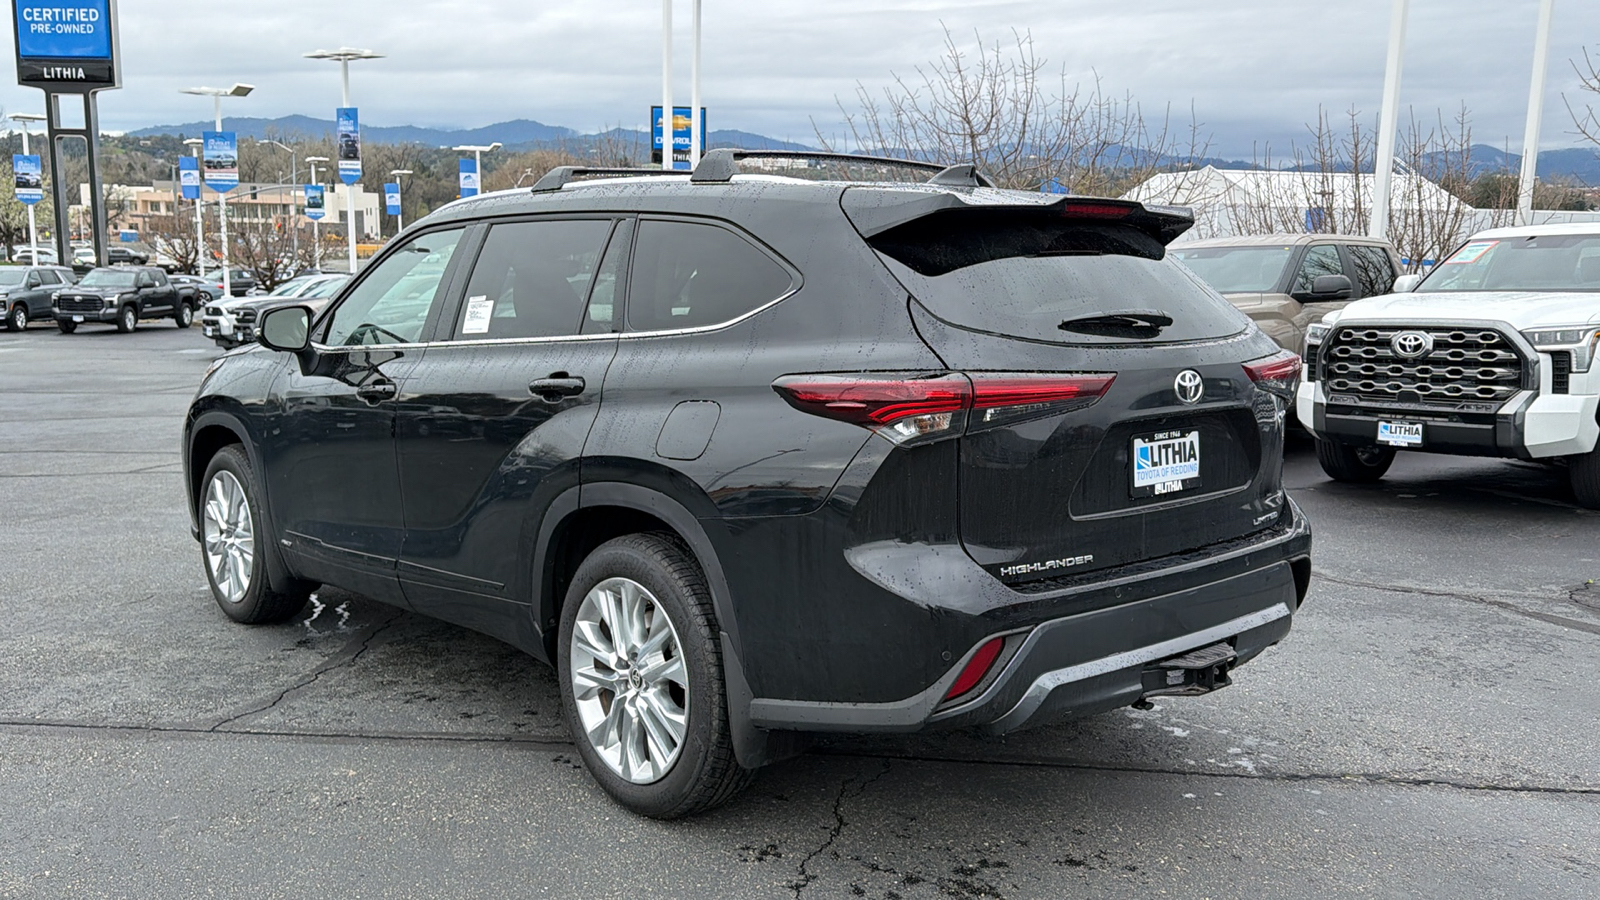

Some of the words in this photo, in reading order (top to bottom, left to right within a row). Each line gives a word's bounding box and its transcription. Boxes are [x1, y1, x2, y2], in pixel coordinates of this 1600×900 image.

[23, 8, 99, 22] CERTIFIED
[30, 23, 94, 34] PRE-OWNED
[43, 67, 85, 79] LITHIA
[1154, 432, 1169, 441] SINCE
[1389, 425, 1421, 436] LITHIA
[1150, 440, 1197, 468] LITHIA
[1137, 469, 1160, 481] TOYOTA
[1161, 467, 1170, 477] OF
[1171, 463, 1198, 476] REDDING
[1162, 480, 1183, 493] LITHIA
[1000, 554, 1094, 576] HIGHLANDER
